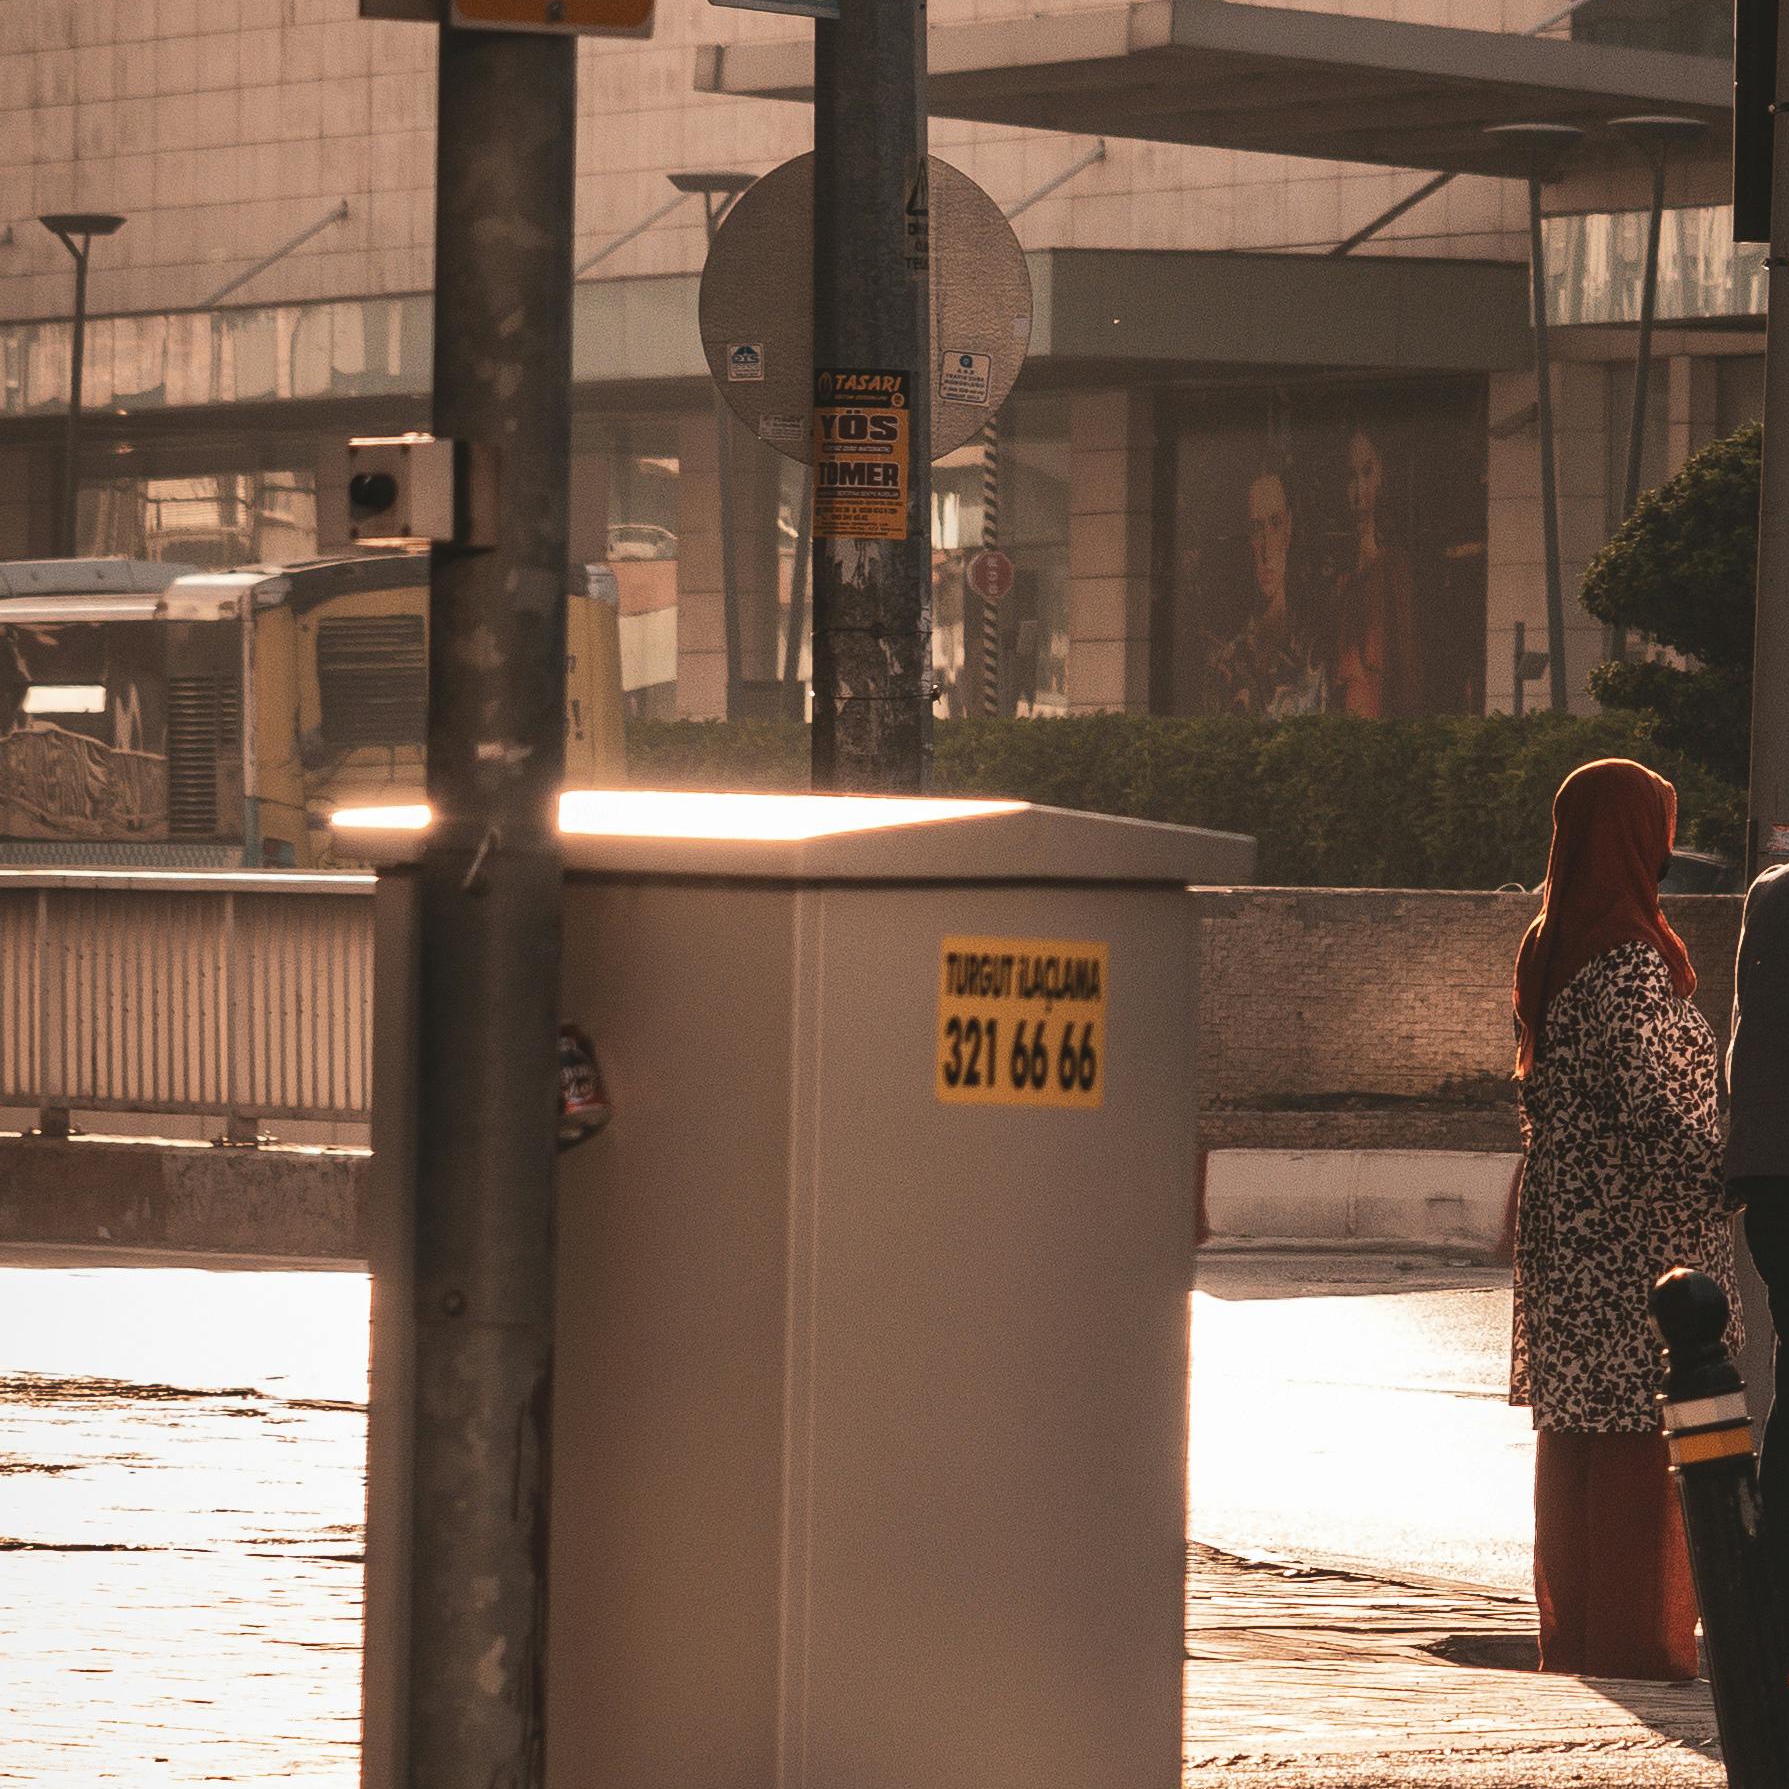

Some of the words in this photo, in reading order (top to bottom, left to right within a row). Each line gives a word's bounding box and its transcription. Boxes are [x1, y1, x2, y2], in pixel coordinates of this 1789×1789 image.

[821, 409, 898, 441] YÖS
[817, 455, 899, 486] TÖMER
[945, 952, 1013, 999] TURGUT
[1016, 956, 1101, 1013] İLAÇLAMA
[943, 1018, 998, 1088] 321
[1009, 1020, 1050, 1091] 66
[1056, 1022, 1098, 1093] 66
